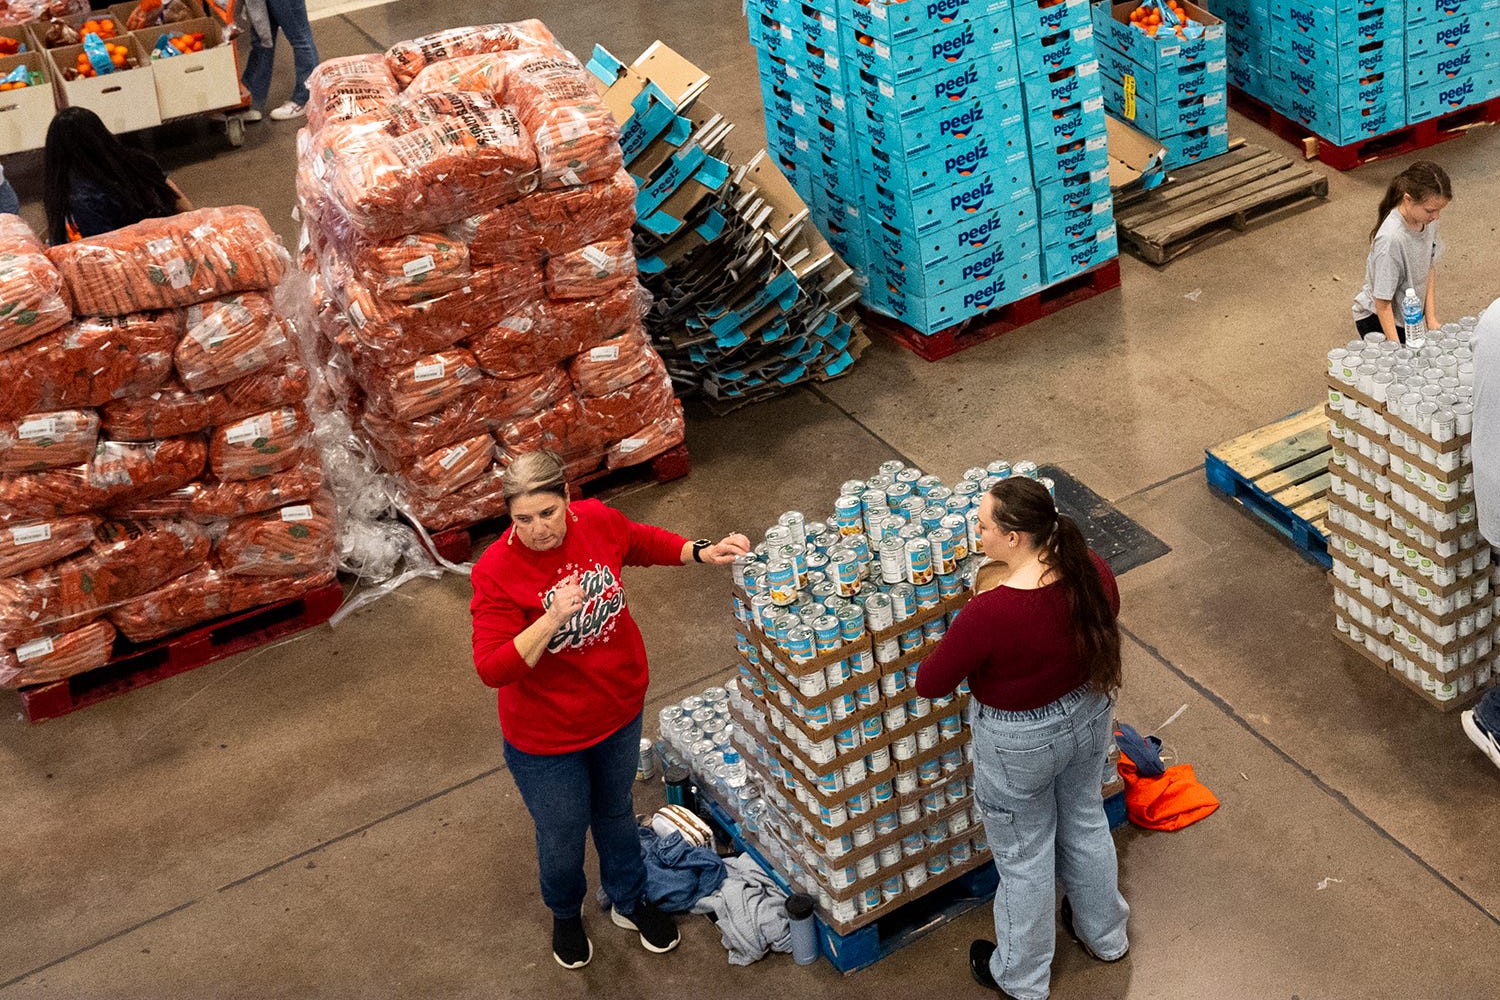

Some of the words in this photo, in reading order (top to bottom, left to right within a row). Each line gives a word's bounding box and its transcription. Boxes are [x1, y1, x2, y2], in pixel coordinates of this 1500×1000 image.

[1040, 9, 1068, 26] peelz
[1291, 9, 1315, 26] peelz
[1437, 24, 1470, 42] peelz
[932, 32, 974, 58] peelz
[1179, 41, 1205, 58] peelz
[1292, 41, 1316, 58] peelz
[1043, 47, 1071, 64] peelz
[1437, 54, 1470, 73] peelz
[935, 70, 978, 97] peelz
[1178, 76, 1205, 92] peelz
[1291, 71, 1315, 89] peelz
[1051, 82, 1078, 98] peelz
[1440, 83, 1473, 101] peelz
[1179, 108, 1206, 122] peelz
[1293, 100, 1316, 120] peelz
[940, 108, 984, 135] peelz
[1054, 118, 1082, 135] peelz
[1183, 140, 1208, 155] peelz
[945, 146, 989, 173] peelz
[1058, 154, 1085, 169] peelz
[651, 166, 680, 198] peelz
[951, 182, 994, 210] peelz
[1063, 187, 1090, 203] peelz
[958, 218, 1000, 246] peelz
[1065, 218, 1092, 235] peelz
[1071, 246, 1098, 264] peelz
[963, 251, 1004, 279] peelz
[964, 280, 1005, 308] peelz
[541, 563, 615, 612] Sta's
